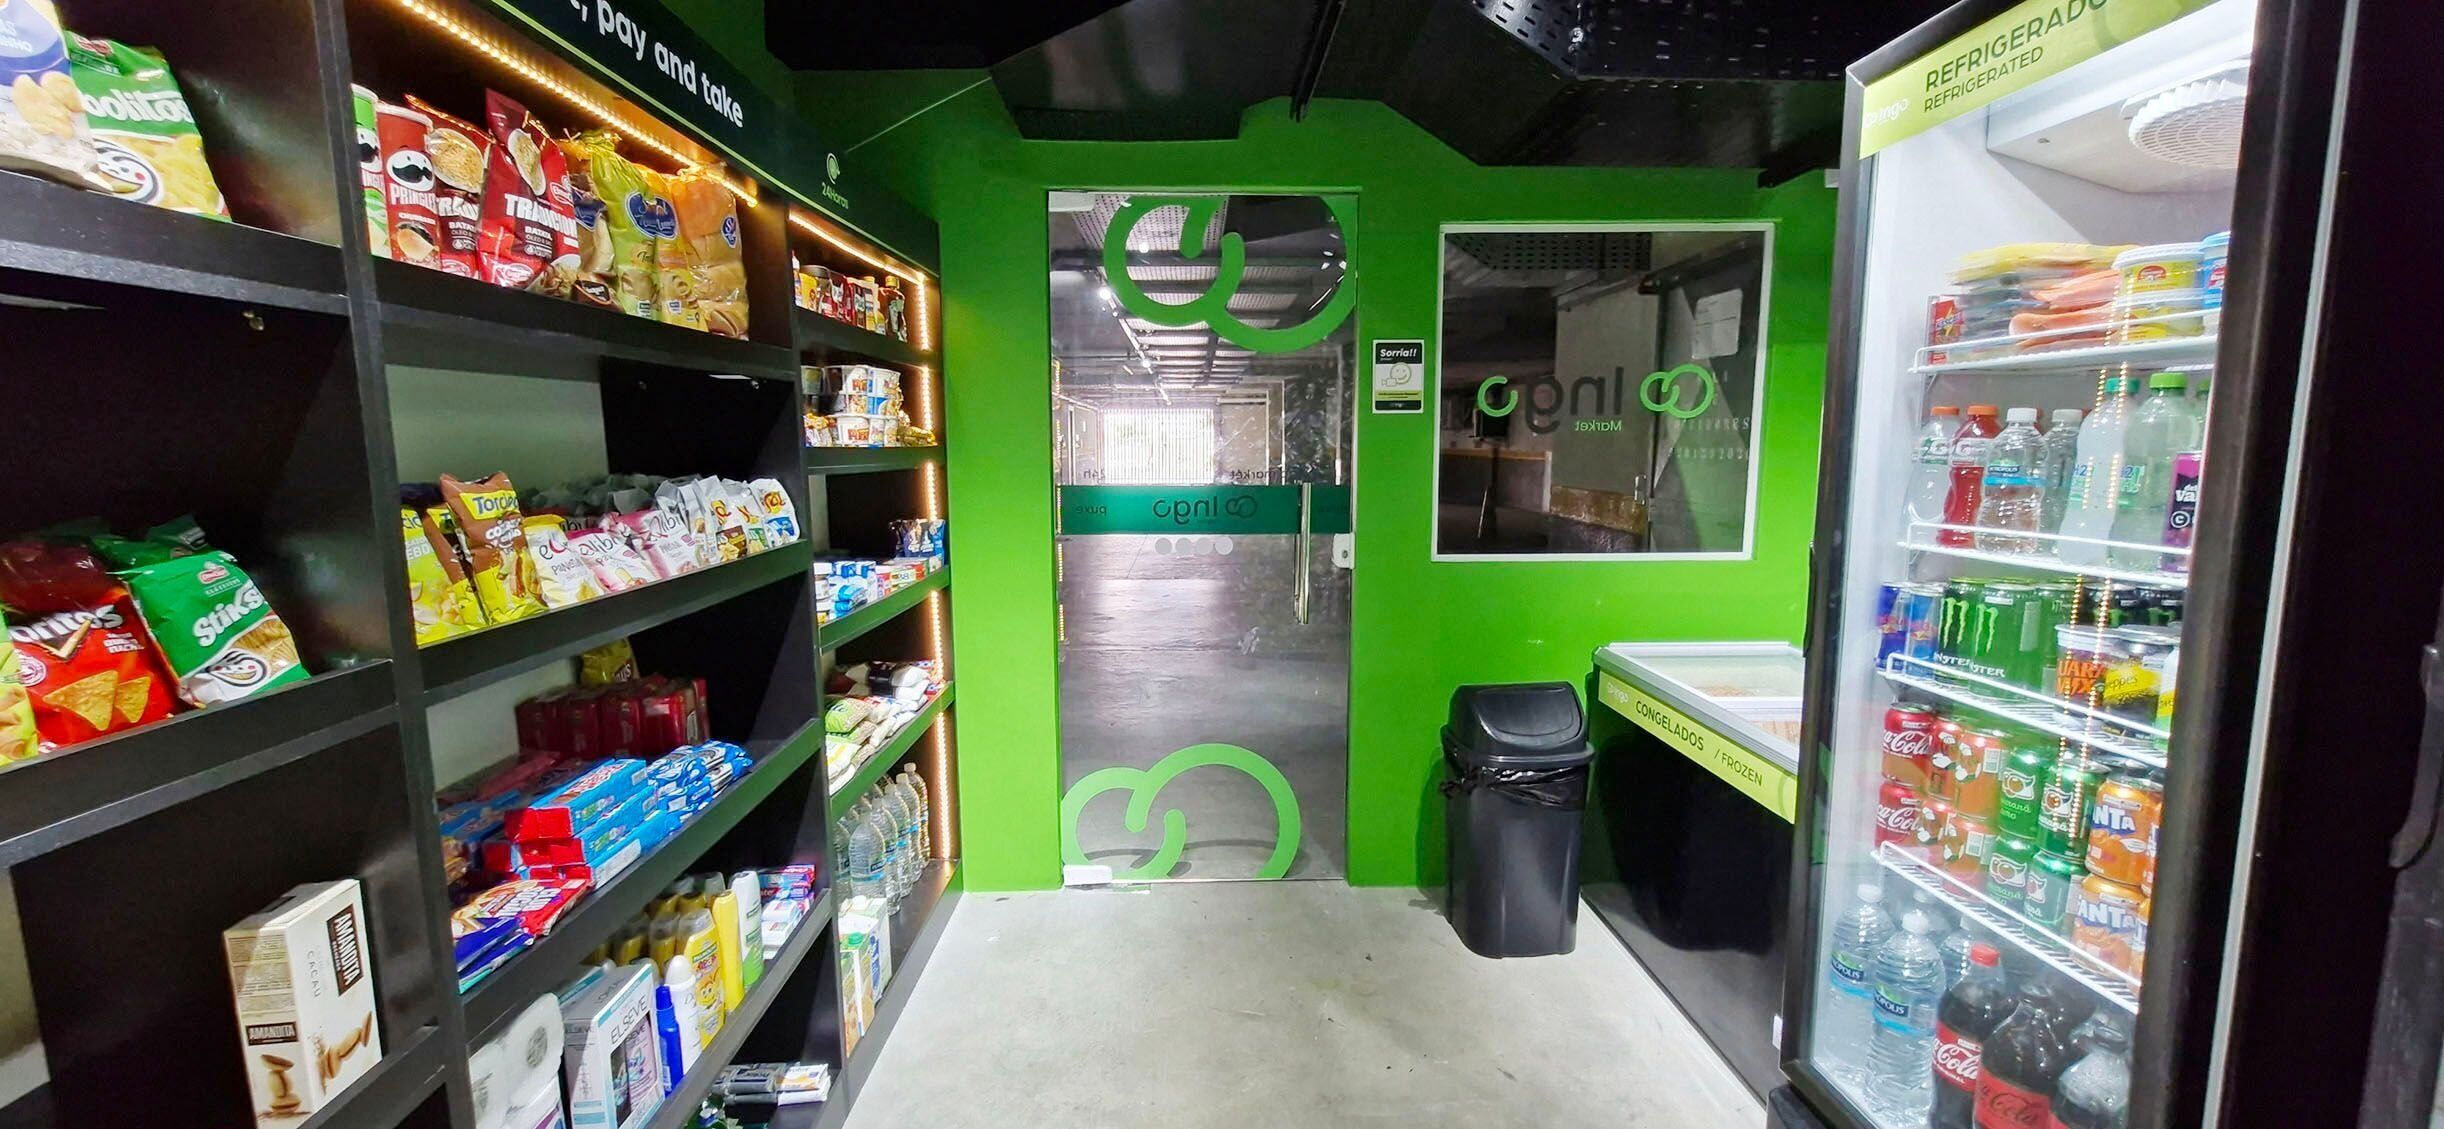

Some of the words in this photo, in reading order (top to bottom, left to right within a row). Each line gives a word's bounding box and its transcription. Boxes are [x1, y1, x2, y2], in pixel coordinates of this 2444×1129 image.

[596, 0, 646, 61] pay
[654, 42, 697, 95] and
[701, 72, 743, 128] take
[1924, 46, 2043, 113] REFRIGERATED
[1380, 347, 1417, 358] Sorria!!
[1635, 700, 1705, 751] CONGELADOS
[1721, 753, 1763, 786] FROZEN
[307, 950, 322, 998] CACAU
[334, 912, 359, 985] AMANDITA
[611, 995, 647, 1044] ELSEVE
